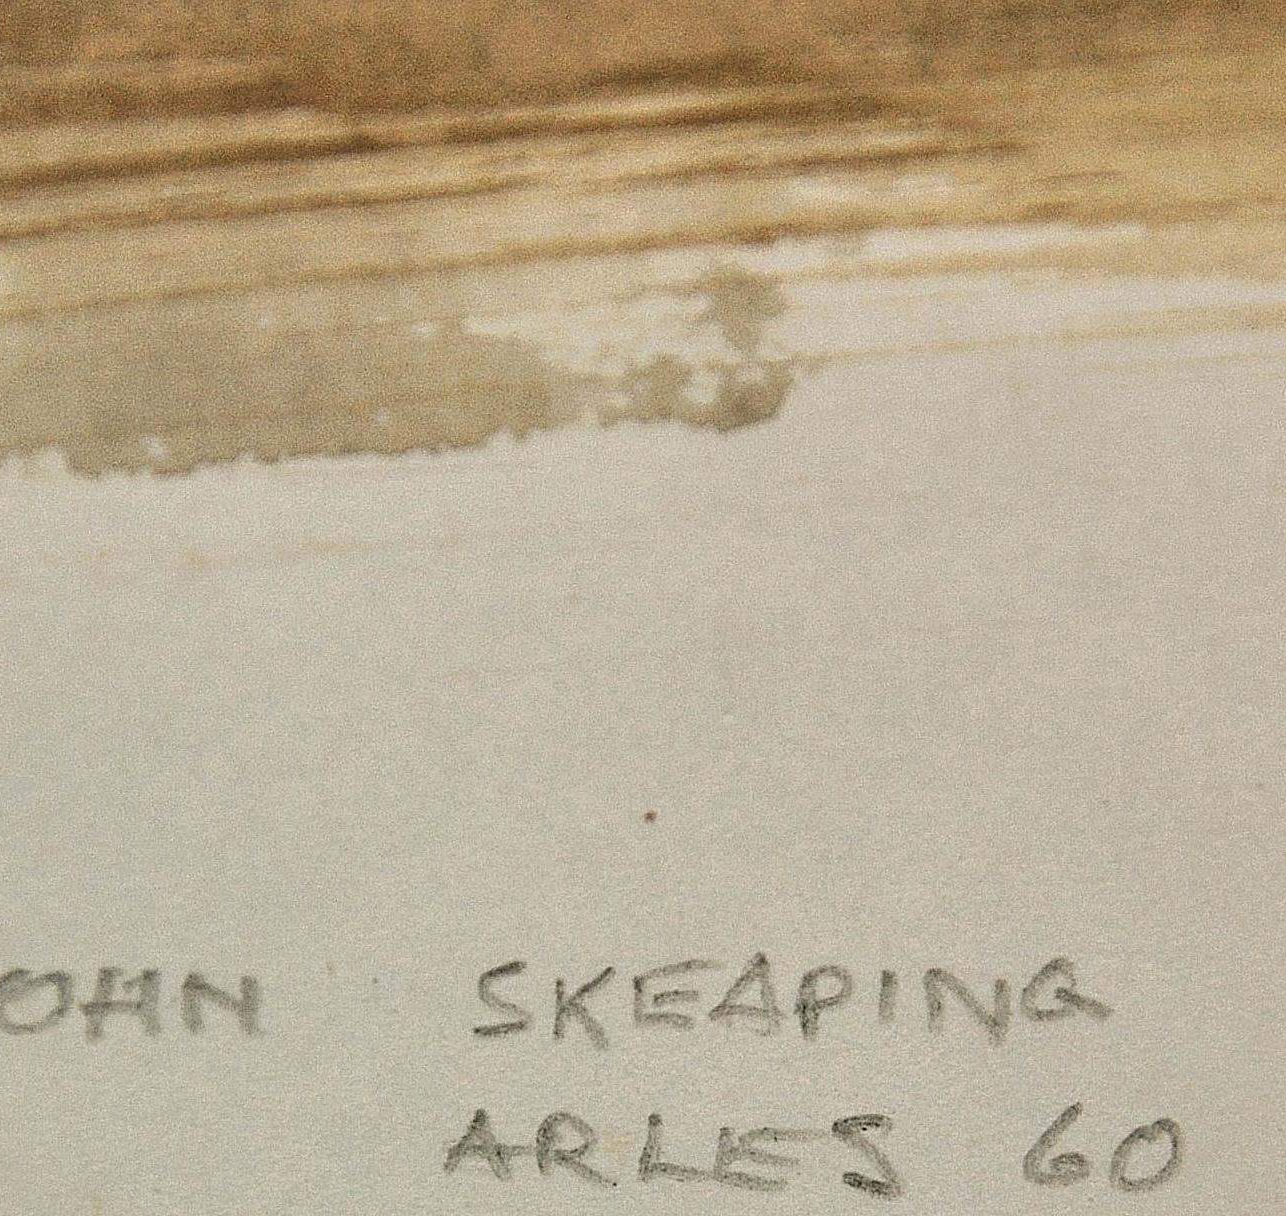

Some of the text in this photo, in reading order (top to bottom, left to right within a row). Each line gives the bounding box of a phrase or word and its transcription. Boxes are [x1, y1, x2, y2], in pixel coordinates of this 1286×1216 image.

[472, 952, 1113, 1049] SKEAPING
[443, 1101, 1184, 1200] ARLES 60
